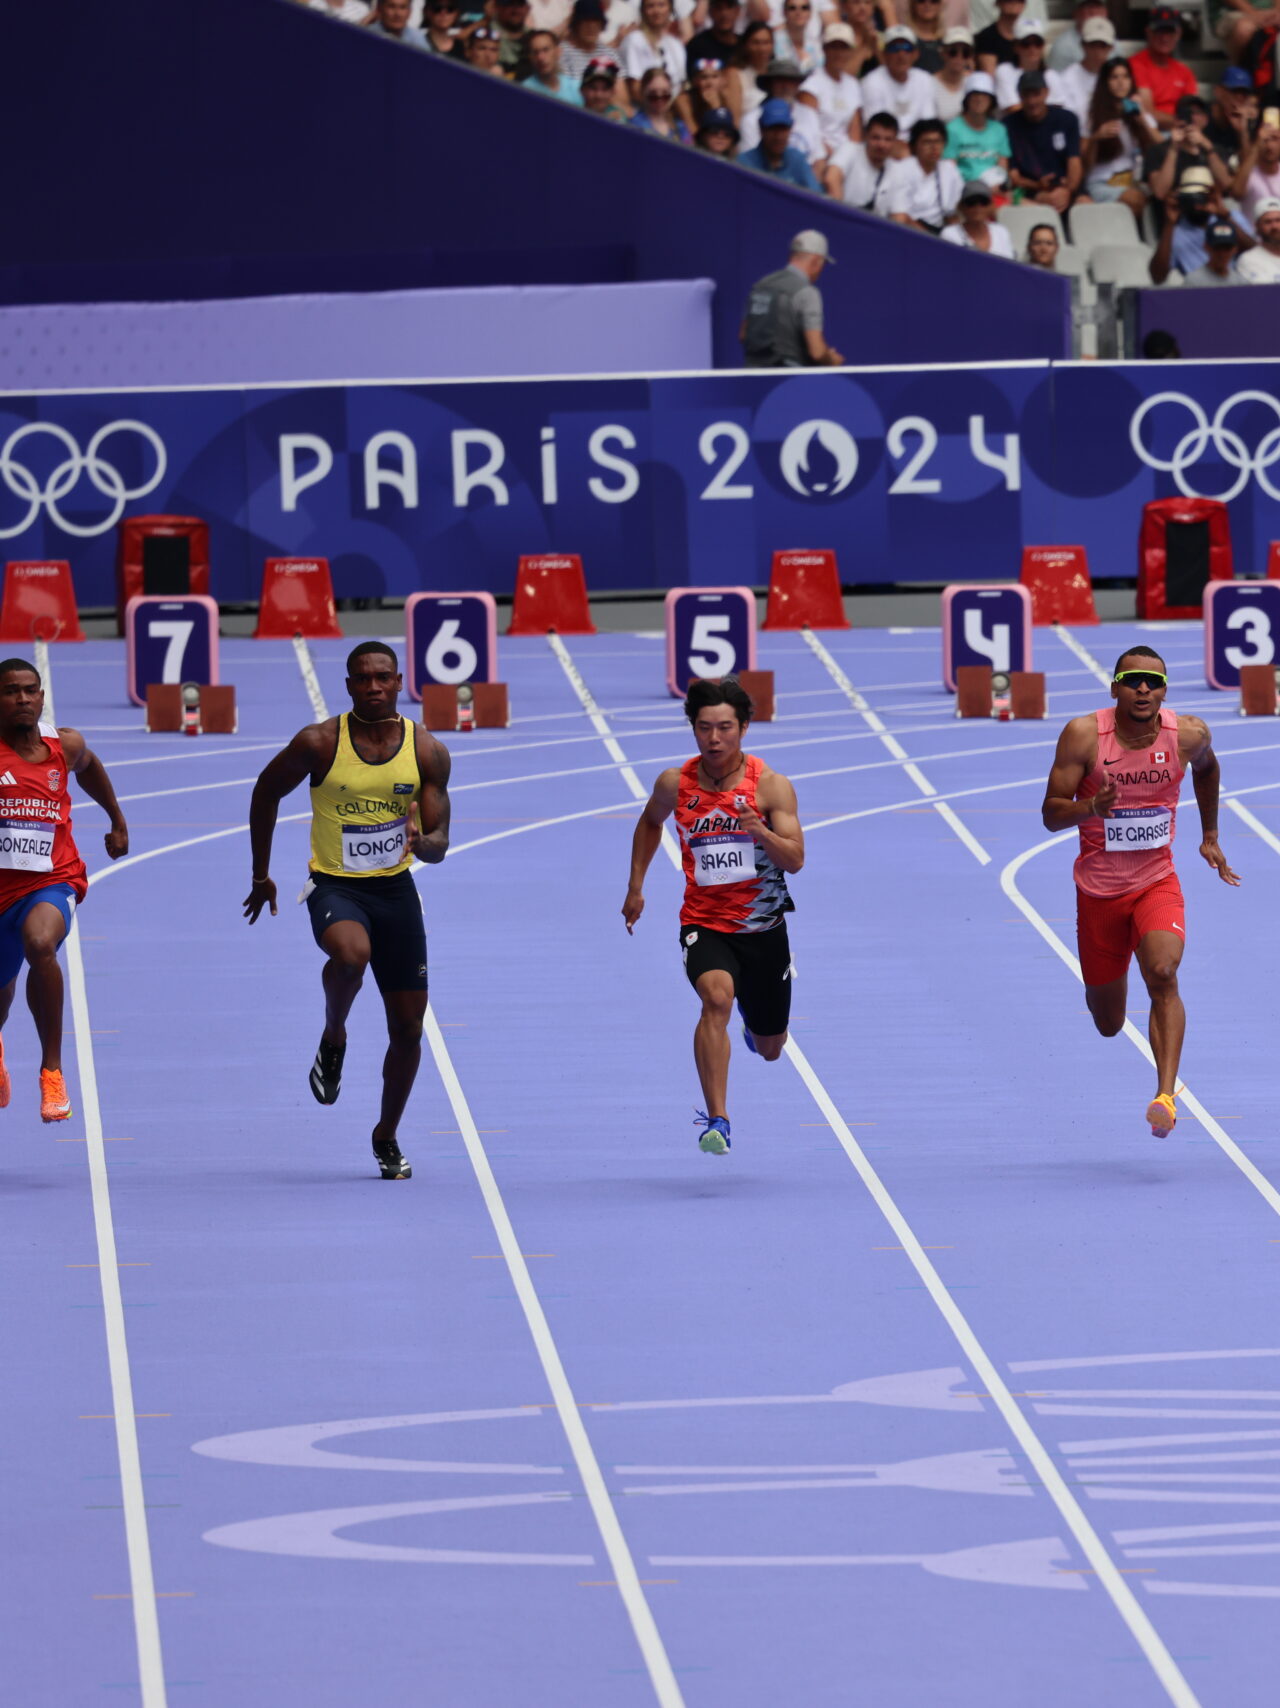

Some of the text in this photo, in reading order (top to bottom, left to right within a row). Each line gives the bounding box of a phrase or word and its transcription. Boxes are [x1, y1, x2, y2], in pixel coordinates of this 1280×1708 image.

[148, 621, 194, 685] 7
[425, 619, 478, 685] 6
[687, 615, 736, 680] 5
[964, 608, 1010, 673] 4
[1224, 606, 1275, 670] 3
[0, 837, 52, 857] ONZALEZ
[349, 833, 404, 857] LONGA
[701, 851, 743, 871] SAKAI
[1107, 821, 1170, 842] DE GRASSE
